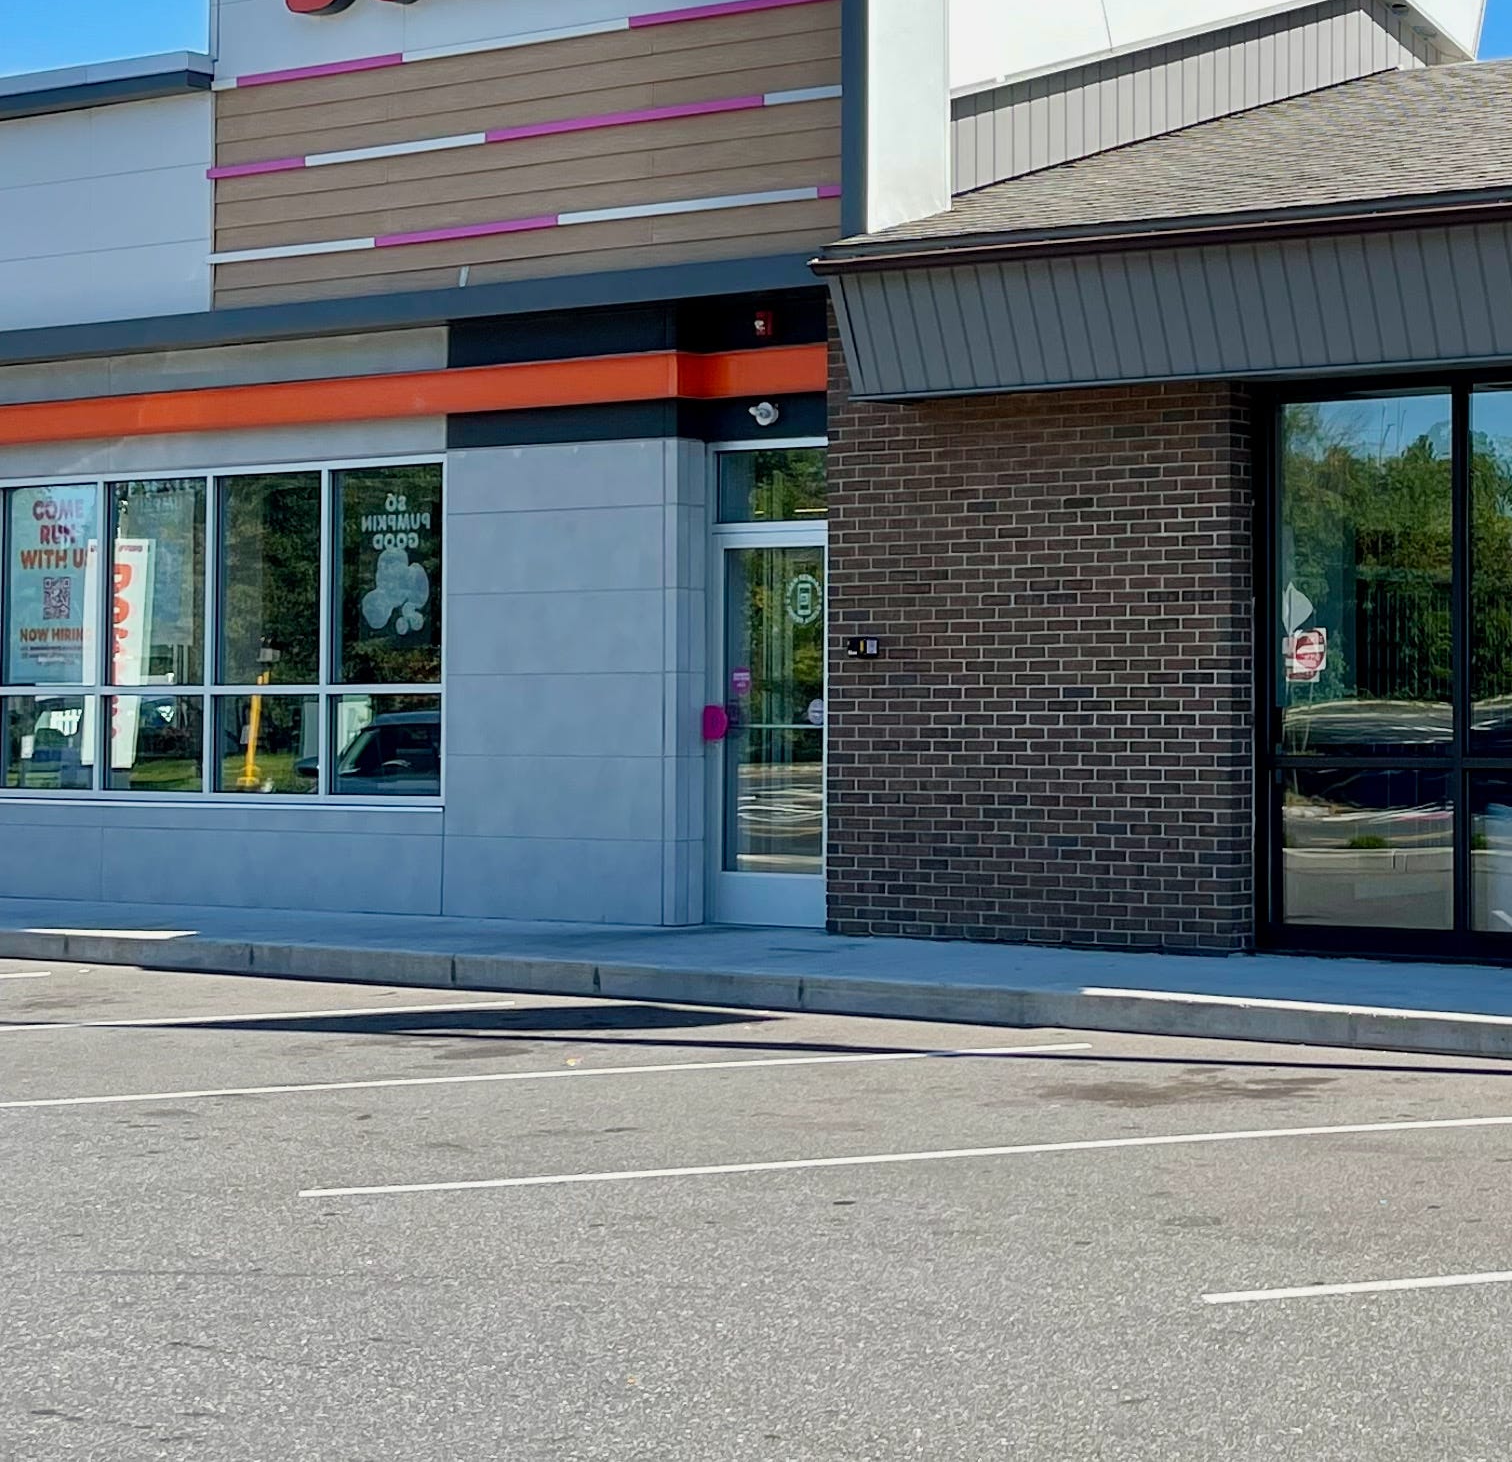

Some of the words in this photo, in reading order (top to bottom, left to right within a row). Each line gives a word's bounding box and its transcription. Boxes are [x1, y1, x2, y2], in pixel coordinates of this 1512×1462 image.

[32, 499, 84, 521] COME
[20, 549, 68, 569] WITH
[20, 628, 48, 642] NOW
